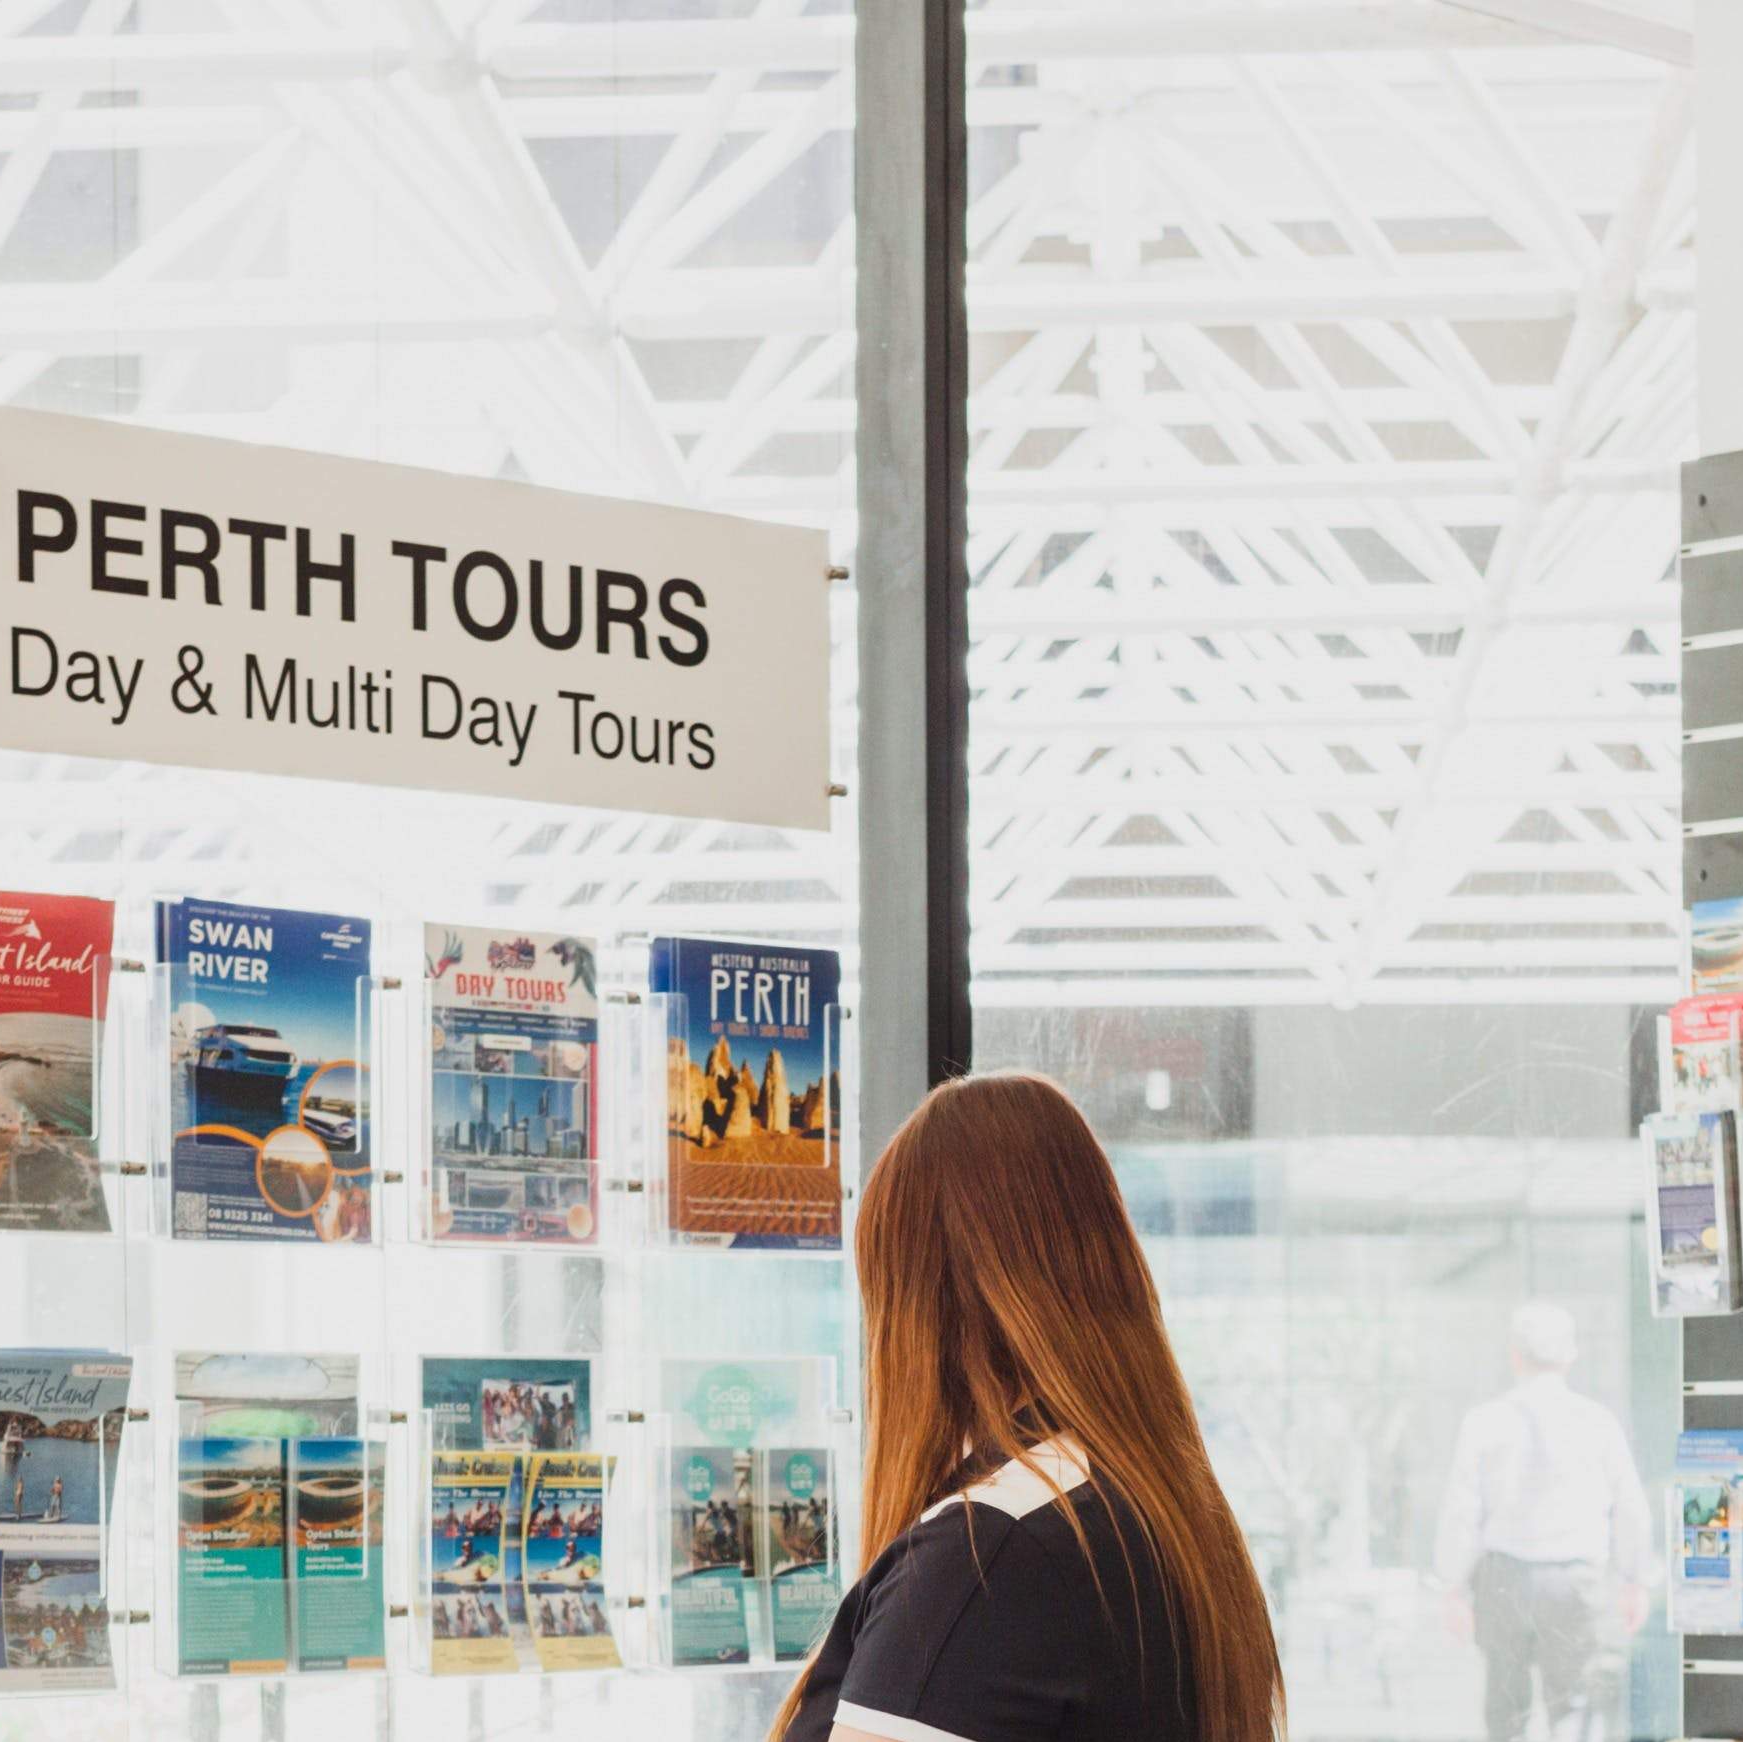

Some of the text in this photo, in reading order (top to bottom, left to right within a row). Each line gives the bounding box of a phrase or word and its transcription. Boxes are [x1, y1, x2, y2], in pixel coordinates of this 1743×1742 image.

[16, 489, 710, 667] PERTH TOURS
[9, 626, 716, 770] Day & Multi Day Tours
[188, 918, 273, 952] SWAN
[16, 941, 93, 974] Island
[188, 951, 269, 983] RIVER
[14, 975, 51, 988] GUIDE
[455, 973, 567, 1003] DAY TOURS
[711, 969, 810, 1026] PERTH
[36, 1374, 102, 1409] Island
